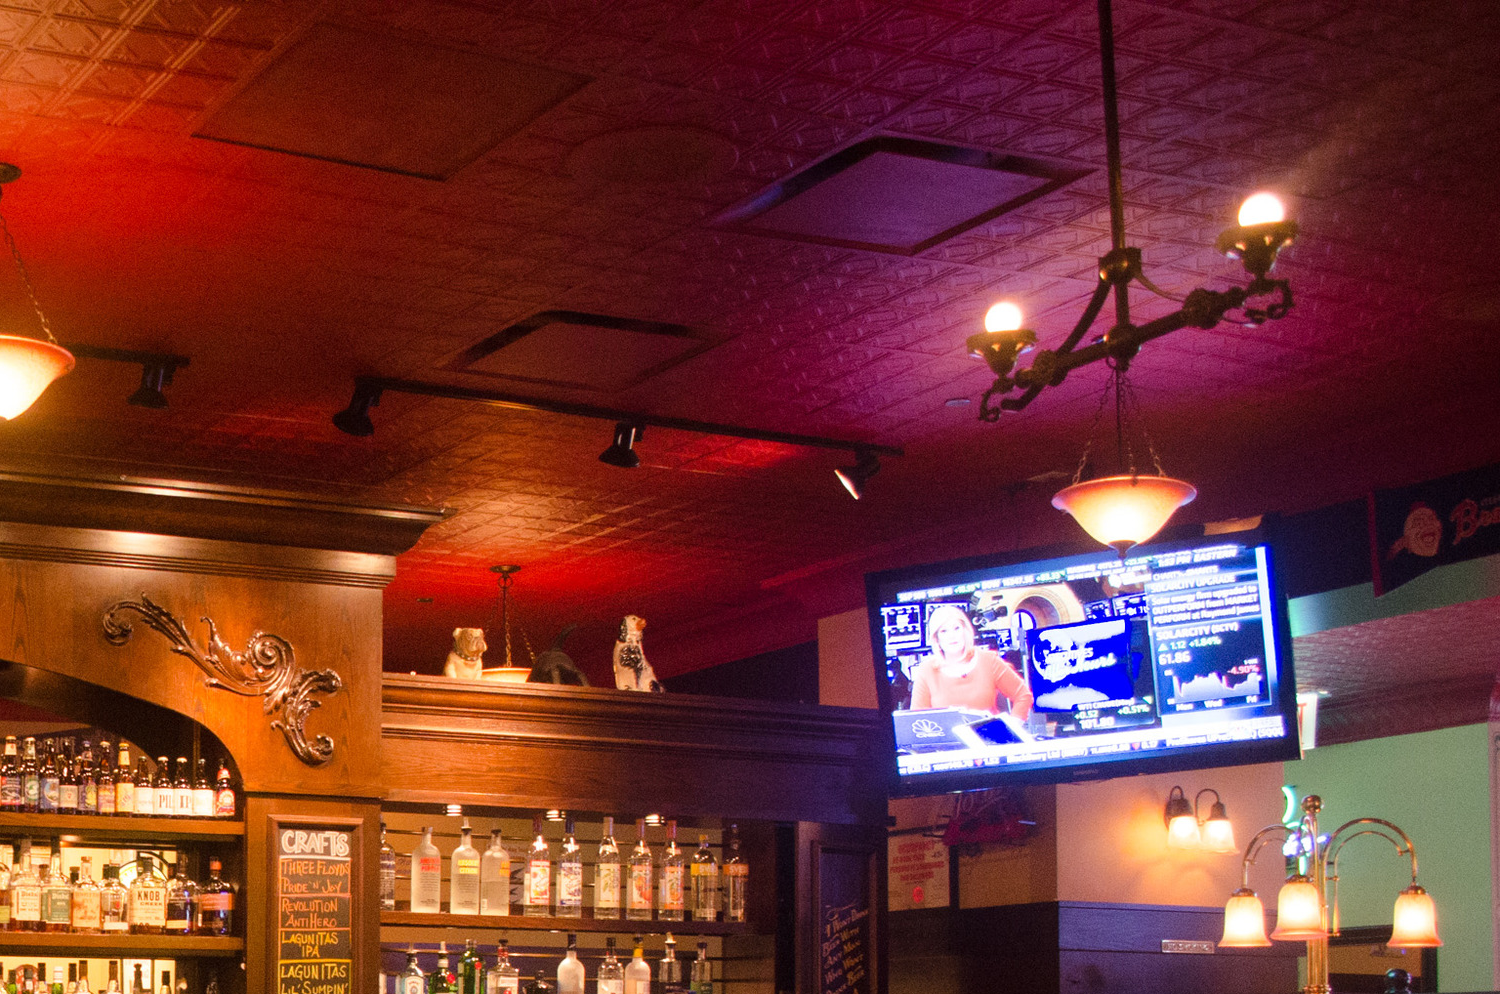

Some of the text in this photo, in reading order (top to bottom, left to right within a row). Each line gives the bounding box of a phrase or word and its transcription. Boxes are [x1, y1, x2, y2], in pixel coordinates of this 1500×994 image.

[1193, 548, 1237, 562] EASTERN
[1151, 574, 1236, 592] SOLARCITY UPGRADE
[1196, 591, 1212, 600] firm
[1247, 585, 1258, 593] to
[1152, 593, 1258, 615] OUTPERFORM from MARKET
[1153, 612, 1191, 624] PERFORM
[1192, 611, 1200, 619] at
[1200, 607, 1237, 619] Raymond
[1156, 626, 1211, 640] SOLARCITY
[1170, 636, 1222, 650] 1.12 +1.84%
[1227, 665, 1260, 675] -4.90%
[1204, 699, 1223, 709] Wed
[1075, 710, 1099, 720] +0.52
[281, 830, 350, 857] CRAFTS
[281, 858, 350, 877] THREE FLOYDS
[282, 877, 309, 895] PRIDE
[137, 890, 160, 901] KNOB
[282, 898, 338, 915] REVOLUTION
[281, 932, 339, 945] LAGUNITAS
[301, 945, 321, 959] IPA
[281, 963, 348, 981] LAGUNITAS
